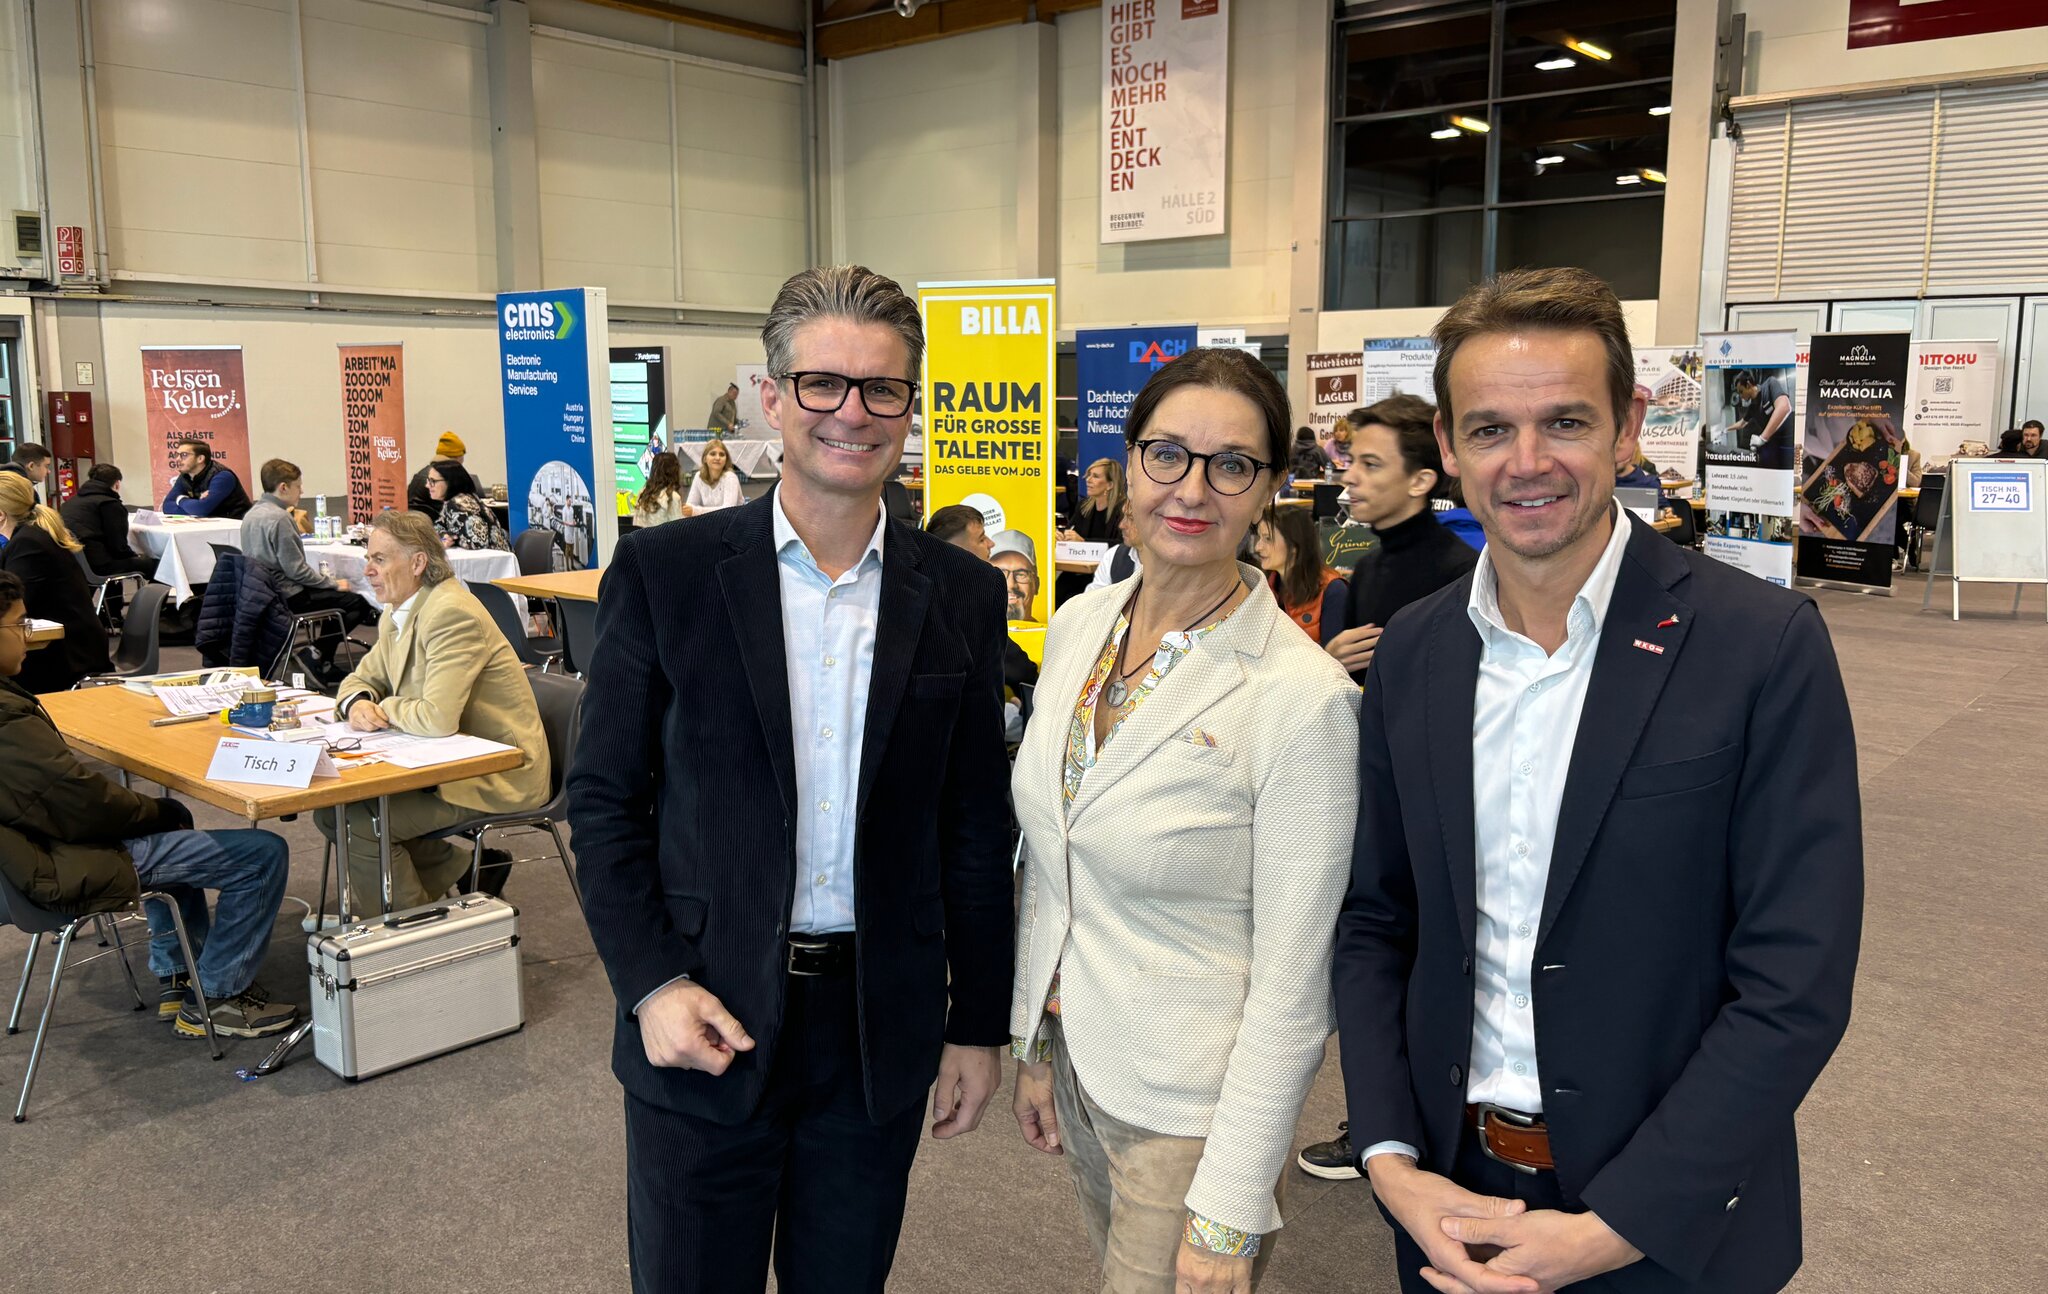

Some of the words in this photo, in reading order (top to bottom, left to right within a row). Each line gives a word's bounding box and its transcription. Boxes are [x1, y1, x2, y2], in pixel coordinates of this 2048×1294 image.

[1111, 0, 1155, 24] HIER
[1111, 20, 1155, 45] GIBT
[1111, 45, 1132, 67] ES
[1111, 60, 1166, 87] NOCH
[1111, 82, 1166, 108] MEHR
[1110, 108, 1135, 129] ZU
[1111, 127, 1147, 150] ENT
[1111, 147, 1161, 171] DECK
[1111, 171, 1134, 192] EN
[1161, 192, 1205, 210] HALLE
[1207, 191, 1216, 205] 2
[1110, 212, 1145, 221] BEGEGNUNG
[1186, 207, 1215, 224] SÜD
[504, 301, 555, 328] cms
[961, 306, 1042, 335] BILLA
[505, 329, 555, 340] electronics
[1129, 339, 1187, 363] DACH
[1400, 353, 1432, 361] Produkte
[345, 356, 396, 371] ARBEIT'MA
[506, 354, 541, 365] Electronic
[151, 369, 222, 391] Felsen
[345, 372, 391, 387] ZOOOOM
[507, 369, 558, 384] Manufacturing
[346, 388, 383, 402] ZOOOM
[508, 383, 538, 396] Services
[1087, 390, 1140, 403] Dachtech
[1820, 388, 1893, 399] MAGNOLIA
[933, 382, 1041, 413] RAUM
[1318, 391, 1355, 403] LAGLER
[347, 404, 375, 418] ZOOM
[565, 403, 584, 412] Austria
[1088, 406, 1104, 418] auf
[563, 413, 584, 424] Hungary
[934, 414, 967, 433] FÜR
[971, 419, 1041, 434] GROSSE
[348, 420, 368, 434] ZOM
[562, 423, 585, 434] Germany
[1087, 421, 1124, 434] Niveau.
[166, 432, 183, 440] ALS
[185, 430, 215, 439] GÄSTE
[349, 435, 369, 449] ZOM
[571, 434, 586, 443] China
[934, 439, 1042, 461] TALENTE!
[350, 451, 370, 465] ZOM
[351, 466, 371, 480] ZOM
[934, 465, 955, 474] DAS
[957, 465, 991, 475] GELBE
[993, 466, 1018, 476] VOM
[1020, 467, 1041, 477] JOB
[352, 482, 372, 496] ZOM
[353, 497, 373, 511] ZOM
[353, 512, 373, 525] ZOM
[1068, 548, 1086, 556] Tisch
[243, 755, 278, 771] Tisch
[286, 759, 296, 772] 3
